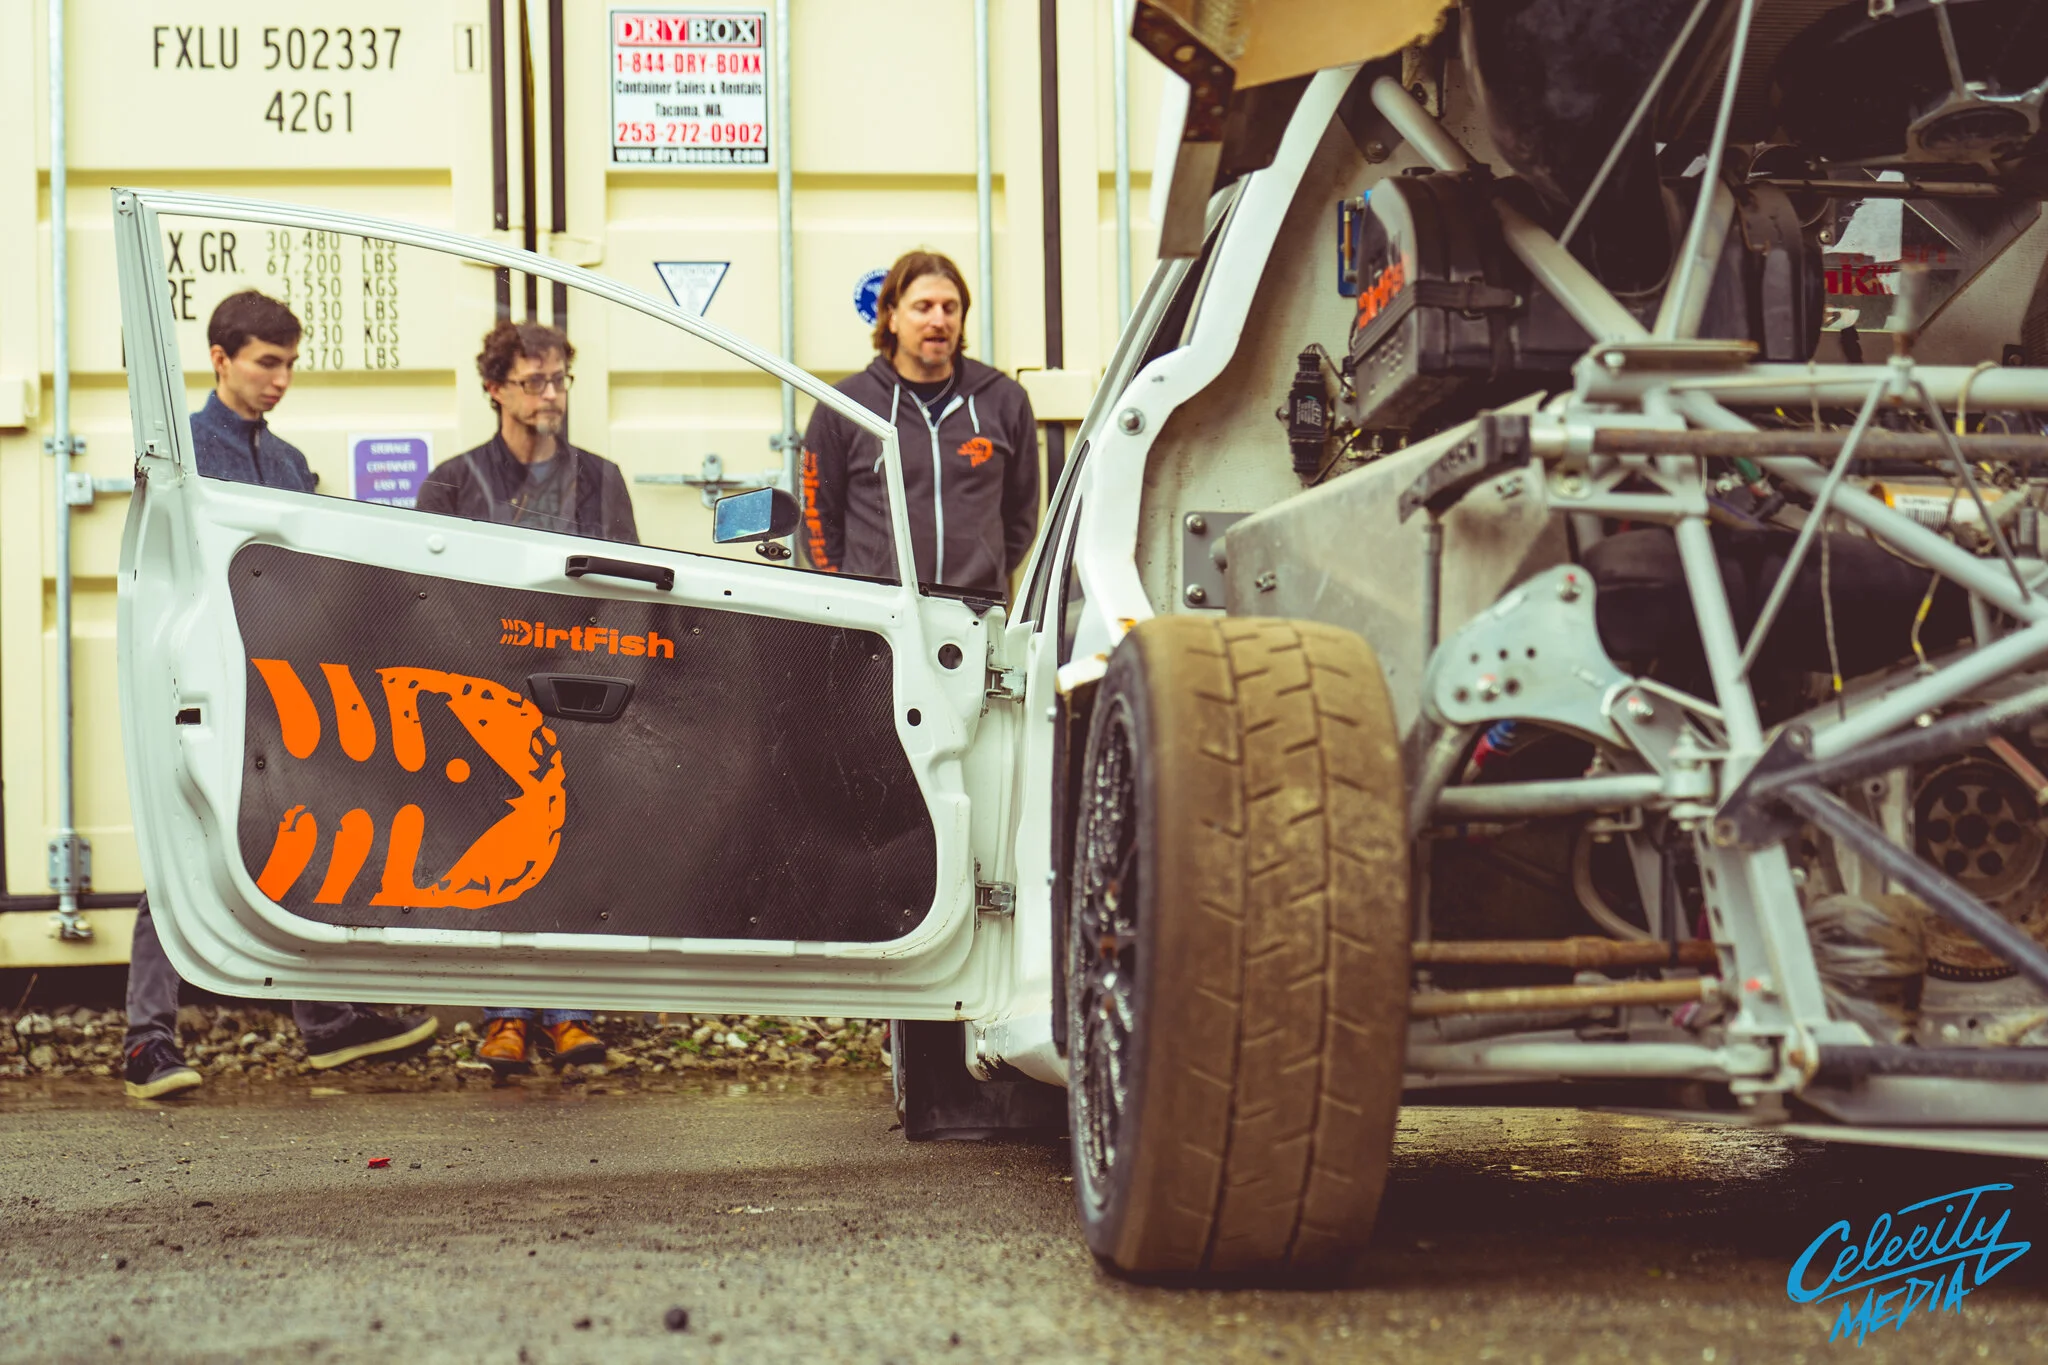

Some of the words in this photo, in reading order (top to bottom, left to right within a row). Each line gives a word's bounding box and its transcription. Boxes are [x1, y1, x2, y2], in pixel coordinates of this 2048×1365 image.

[153, 26, 239, 69] FXLU
[263, 27, 401, 70] 502337
[465, 28, 475, 70] 1
[617, 53, 761, 73] 1-844-DRY-BOXX
[616, 80, 671, 95] Container
[676, 81, 706, 95] Sales
[720, 80, 762, 95] Rentals
[264, 91, 353, 132] 42G1
[617, 122, 763, 143] 253-272-0902
[266, 230, 340, 252] 30.480
[266, 253, 341, 275] 67.200
[362, 252, 397, 275] LBS
[168, 278, 197, 321] RE
[281, 277, 342, 299] 3.550
[362, 276, 398, 298] KGS
[363, 300, 399, 321] LBS
[304, 323, 343, 345] 930
[363, 323, 399, 345] KGS
[363, 347, 400, 370] LBS
[500, 618, 675, 659] DirtFish
